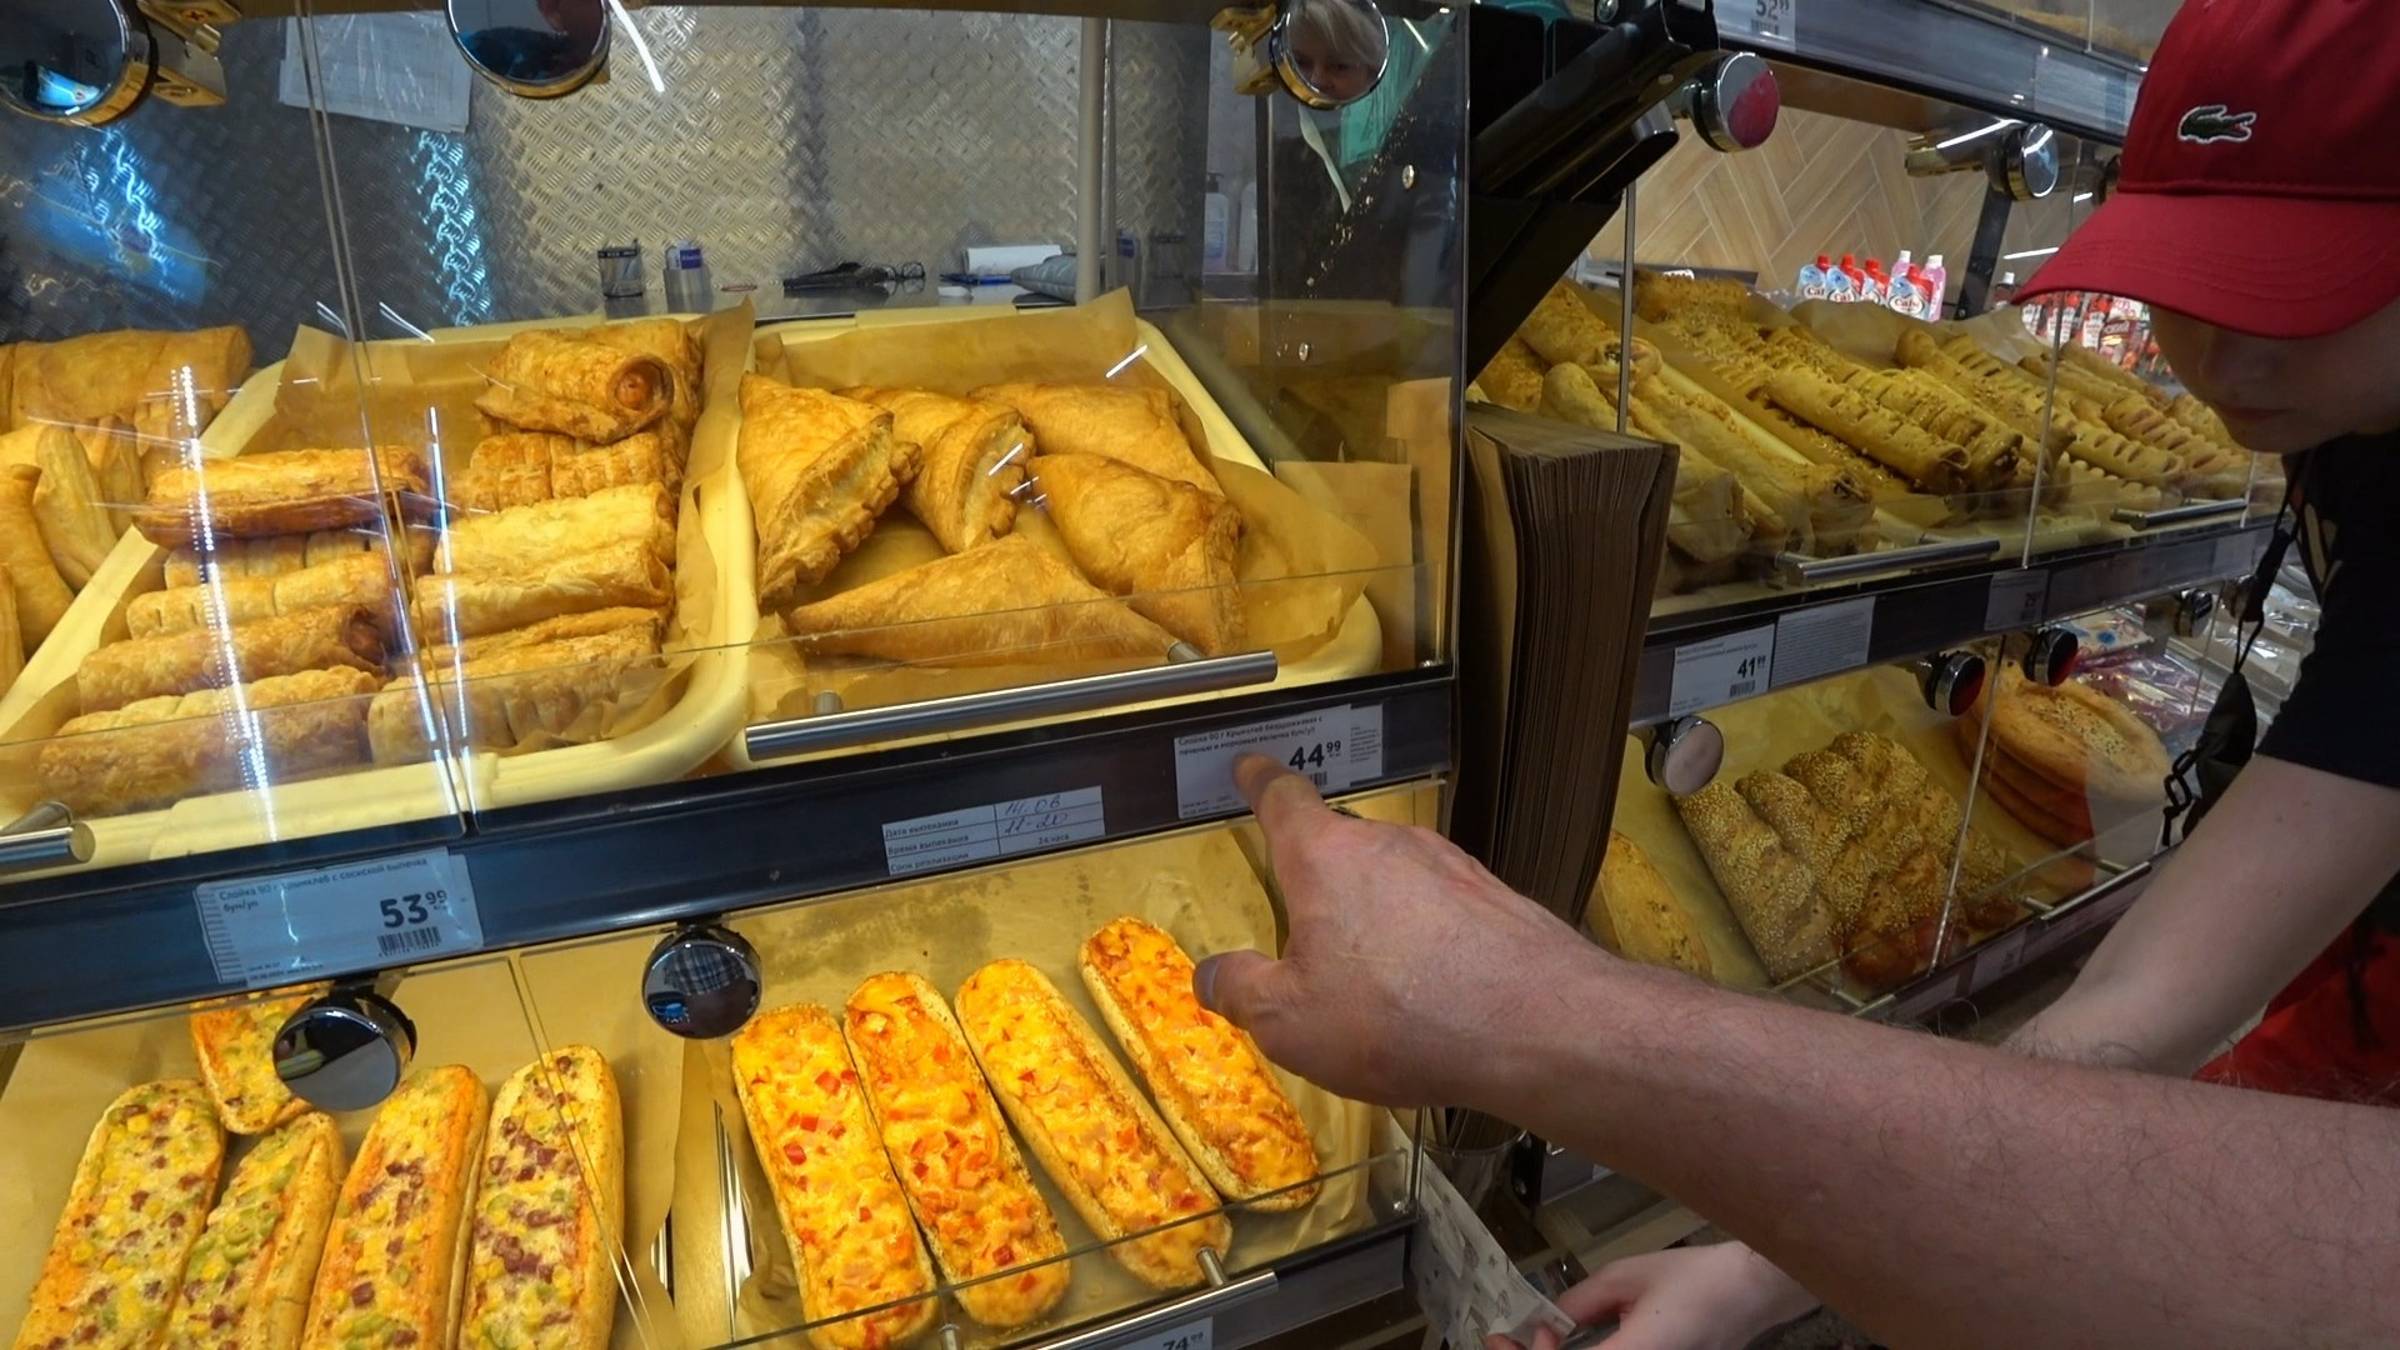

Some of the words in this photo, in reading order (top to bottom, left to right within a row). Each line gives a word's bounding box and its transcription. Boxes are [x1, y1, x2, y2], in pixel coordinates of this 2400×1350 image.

[1737, 657, 1755, 678] 41
[1289, 743, 1324, 770] 44
[1326, 740, 1341, 753] 99
[380, 894, 428, 928] 53
[425, 890, 448, 905] 99
